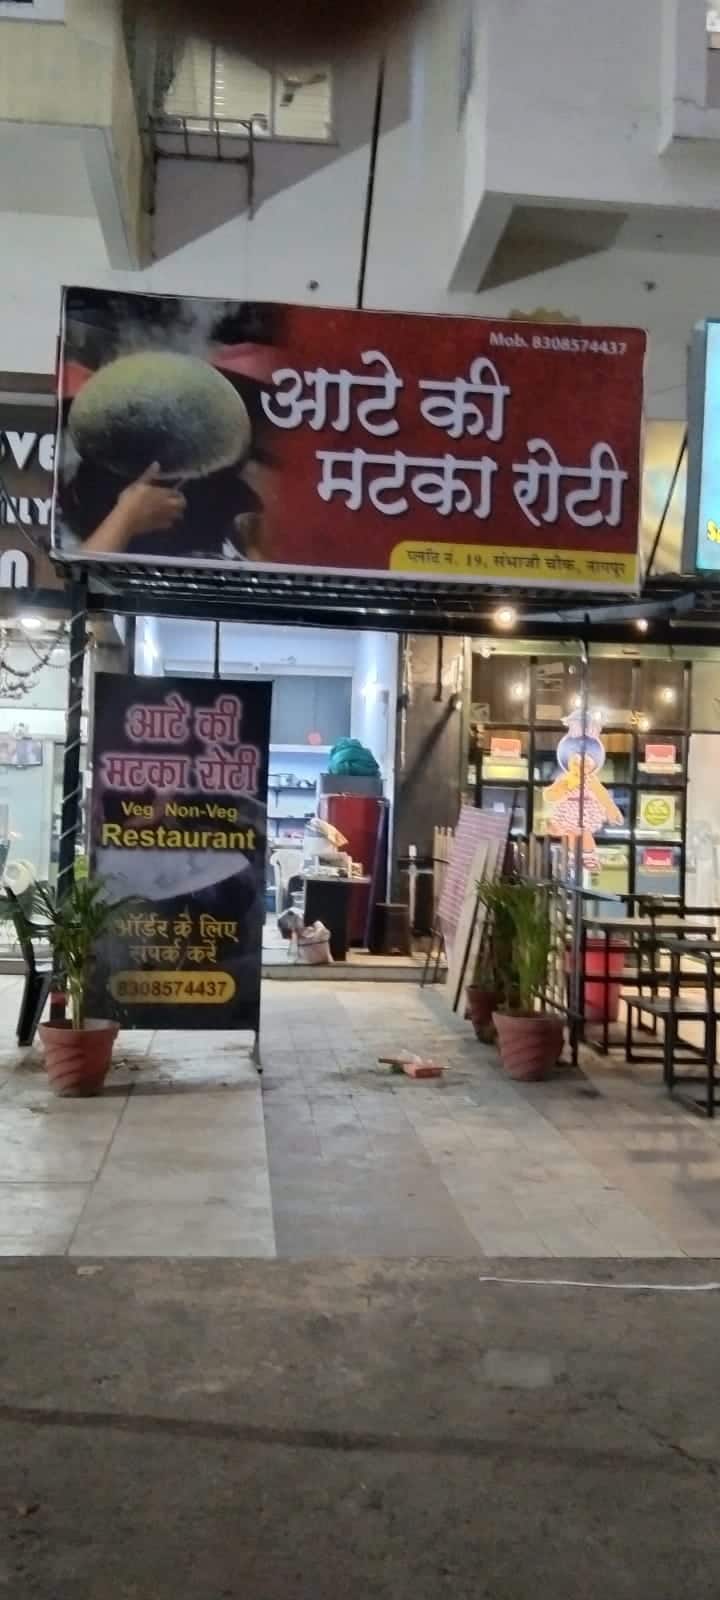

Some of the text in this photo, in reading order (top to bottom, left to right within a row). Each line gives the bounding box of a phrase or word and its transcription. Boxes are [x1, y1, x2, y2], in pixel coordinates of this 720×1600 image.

[489, 332, 627, 355] Mob. 8308574437
[260, 350, 511, 442] आटे की
[0, 431, 55, 472] VE
[315, 438, 628, 527] मटका रोटी
[126, 693, 242, 744] आटे की
[102, 744, 259, 794] मटका रोटी
[121, 801, 239, 821] Veg Non-Veg
[102, 823, 256, 850] Restaurant
[173, 913, 193, 938] के
[199, 912, 239, 942] लिए
[116, 980, 228, 997] 8308574437
